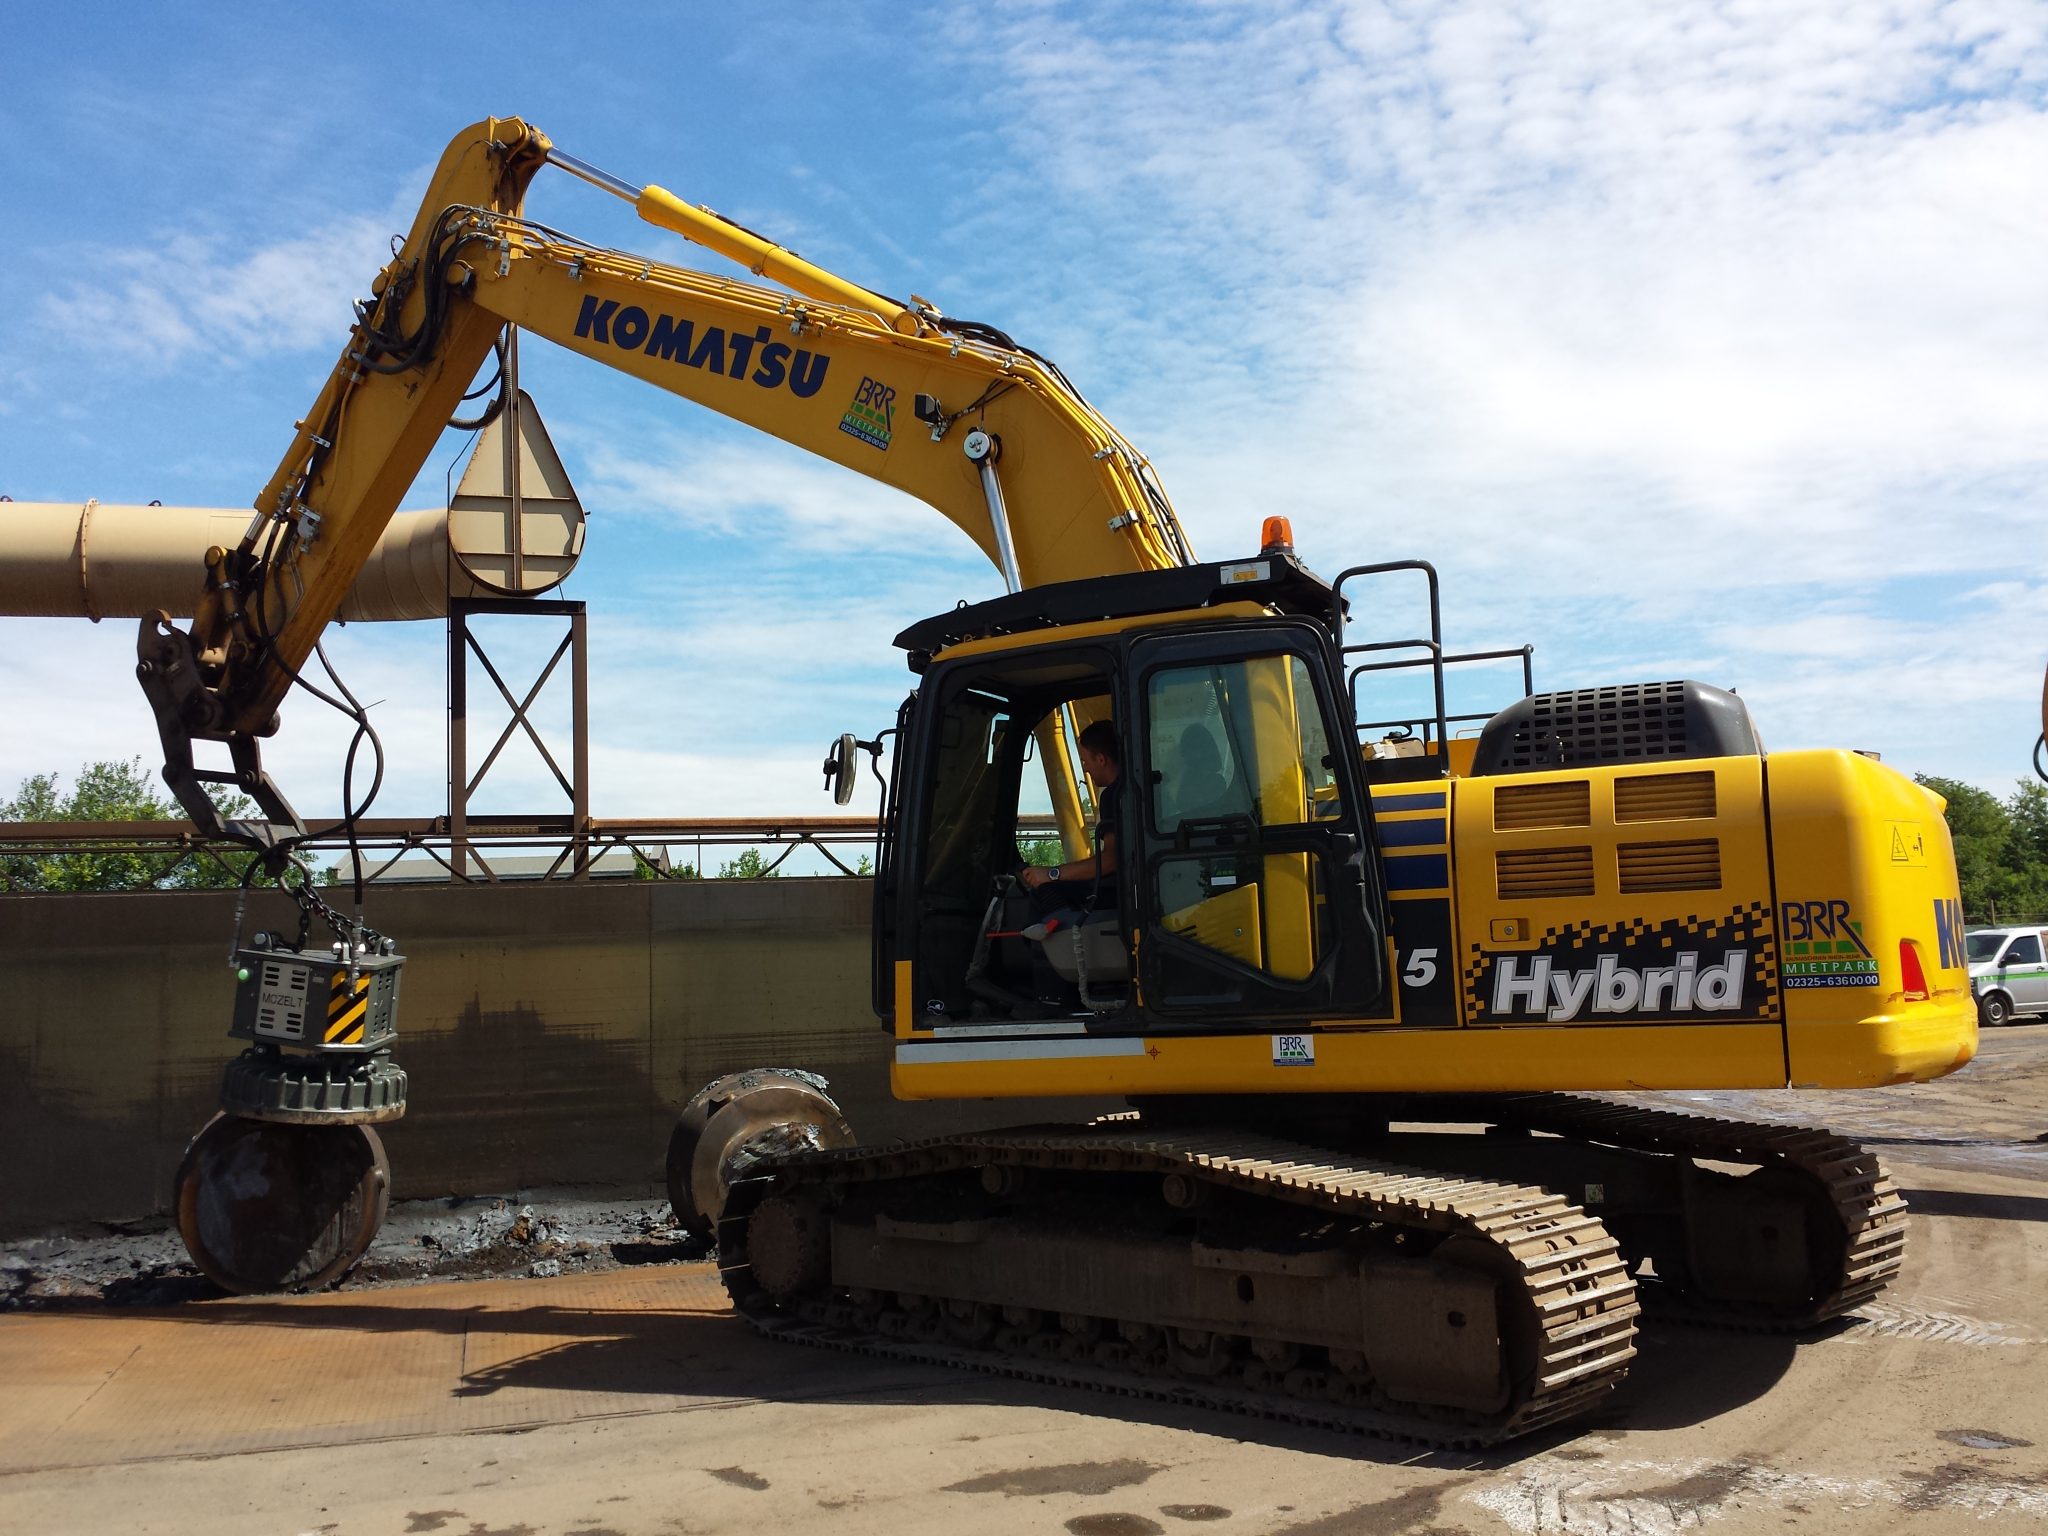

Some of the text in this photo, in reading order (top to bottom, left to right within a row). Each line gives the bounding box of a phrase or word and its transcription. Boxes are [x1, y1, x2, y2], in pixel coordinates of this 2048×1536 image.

[574, 294, 831, 398] KOMATSU
[854, 376, 896, 432] BRR
[844, 414, 891, 441] MIETPARK
[1781, 900, 1873, 958] BRR
[1394, 948, 1438, 987] 5
[1491, 949, 1748, 1022] Hybrid
[1785, 961, 1877, 974] MIETPARK
[1786, 975, 1878, 987] 02325-6360000
[1279, 1036, 1309, 1058] BRR
